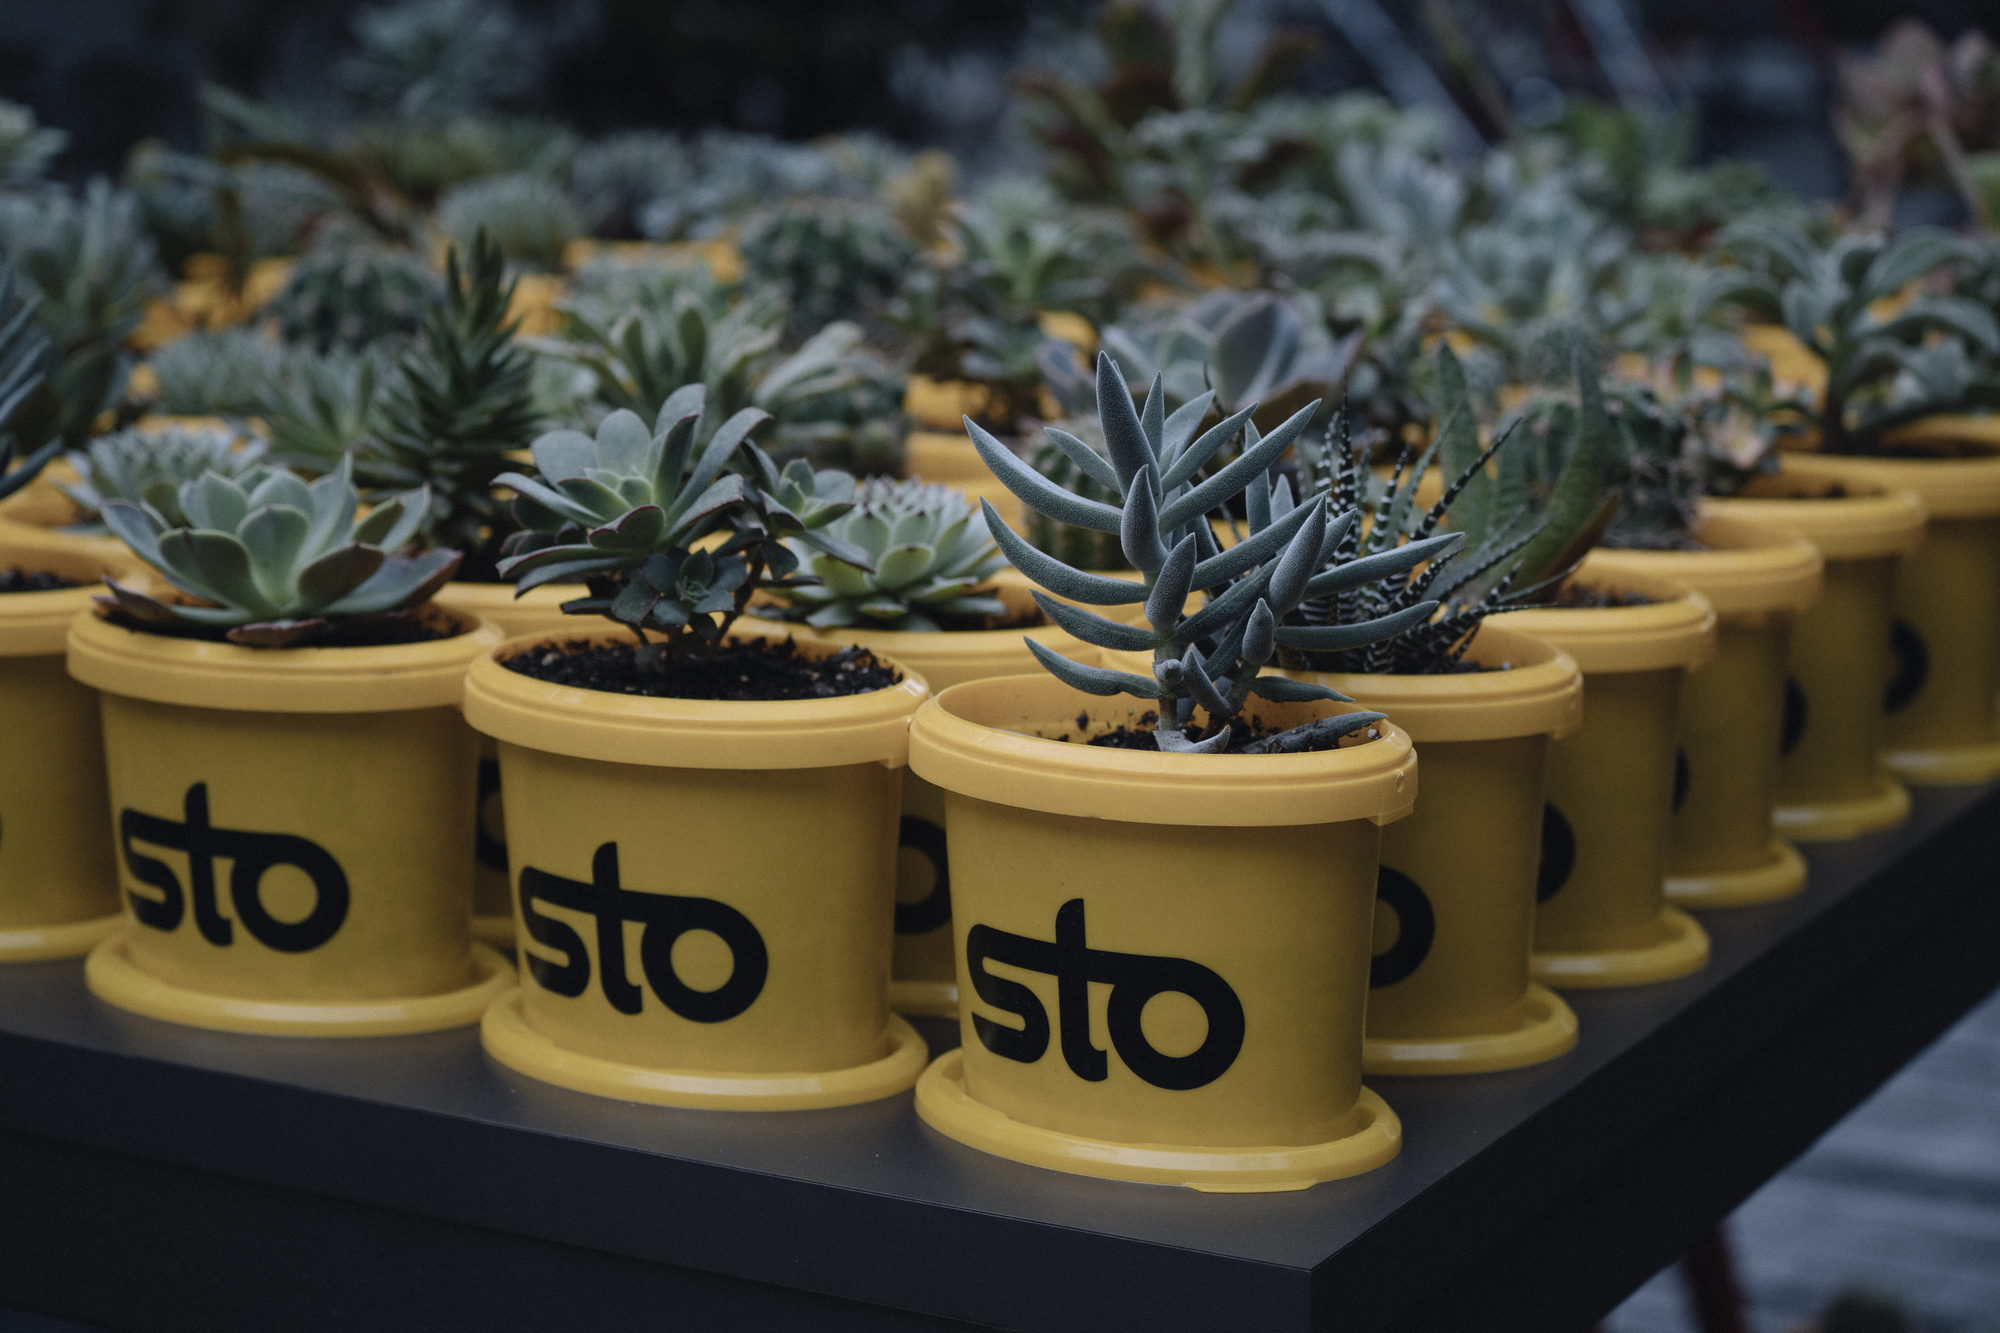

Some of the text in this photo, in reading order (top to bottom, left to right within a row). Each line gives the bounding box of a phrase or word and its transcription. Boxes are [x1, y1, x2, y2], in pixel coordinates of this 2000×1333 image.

[120, 781, 350, 953] sto
[519, 841, 769, 1024] sto
[967, 897, 1246, 1091] sto
